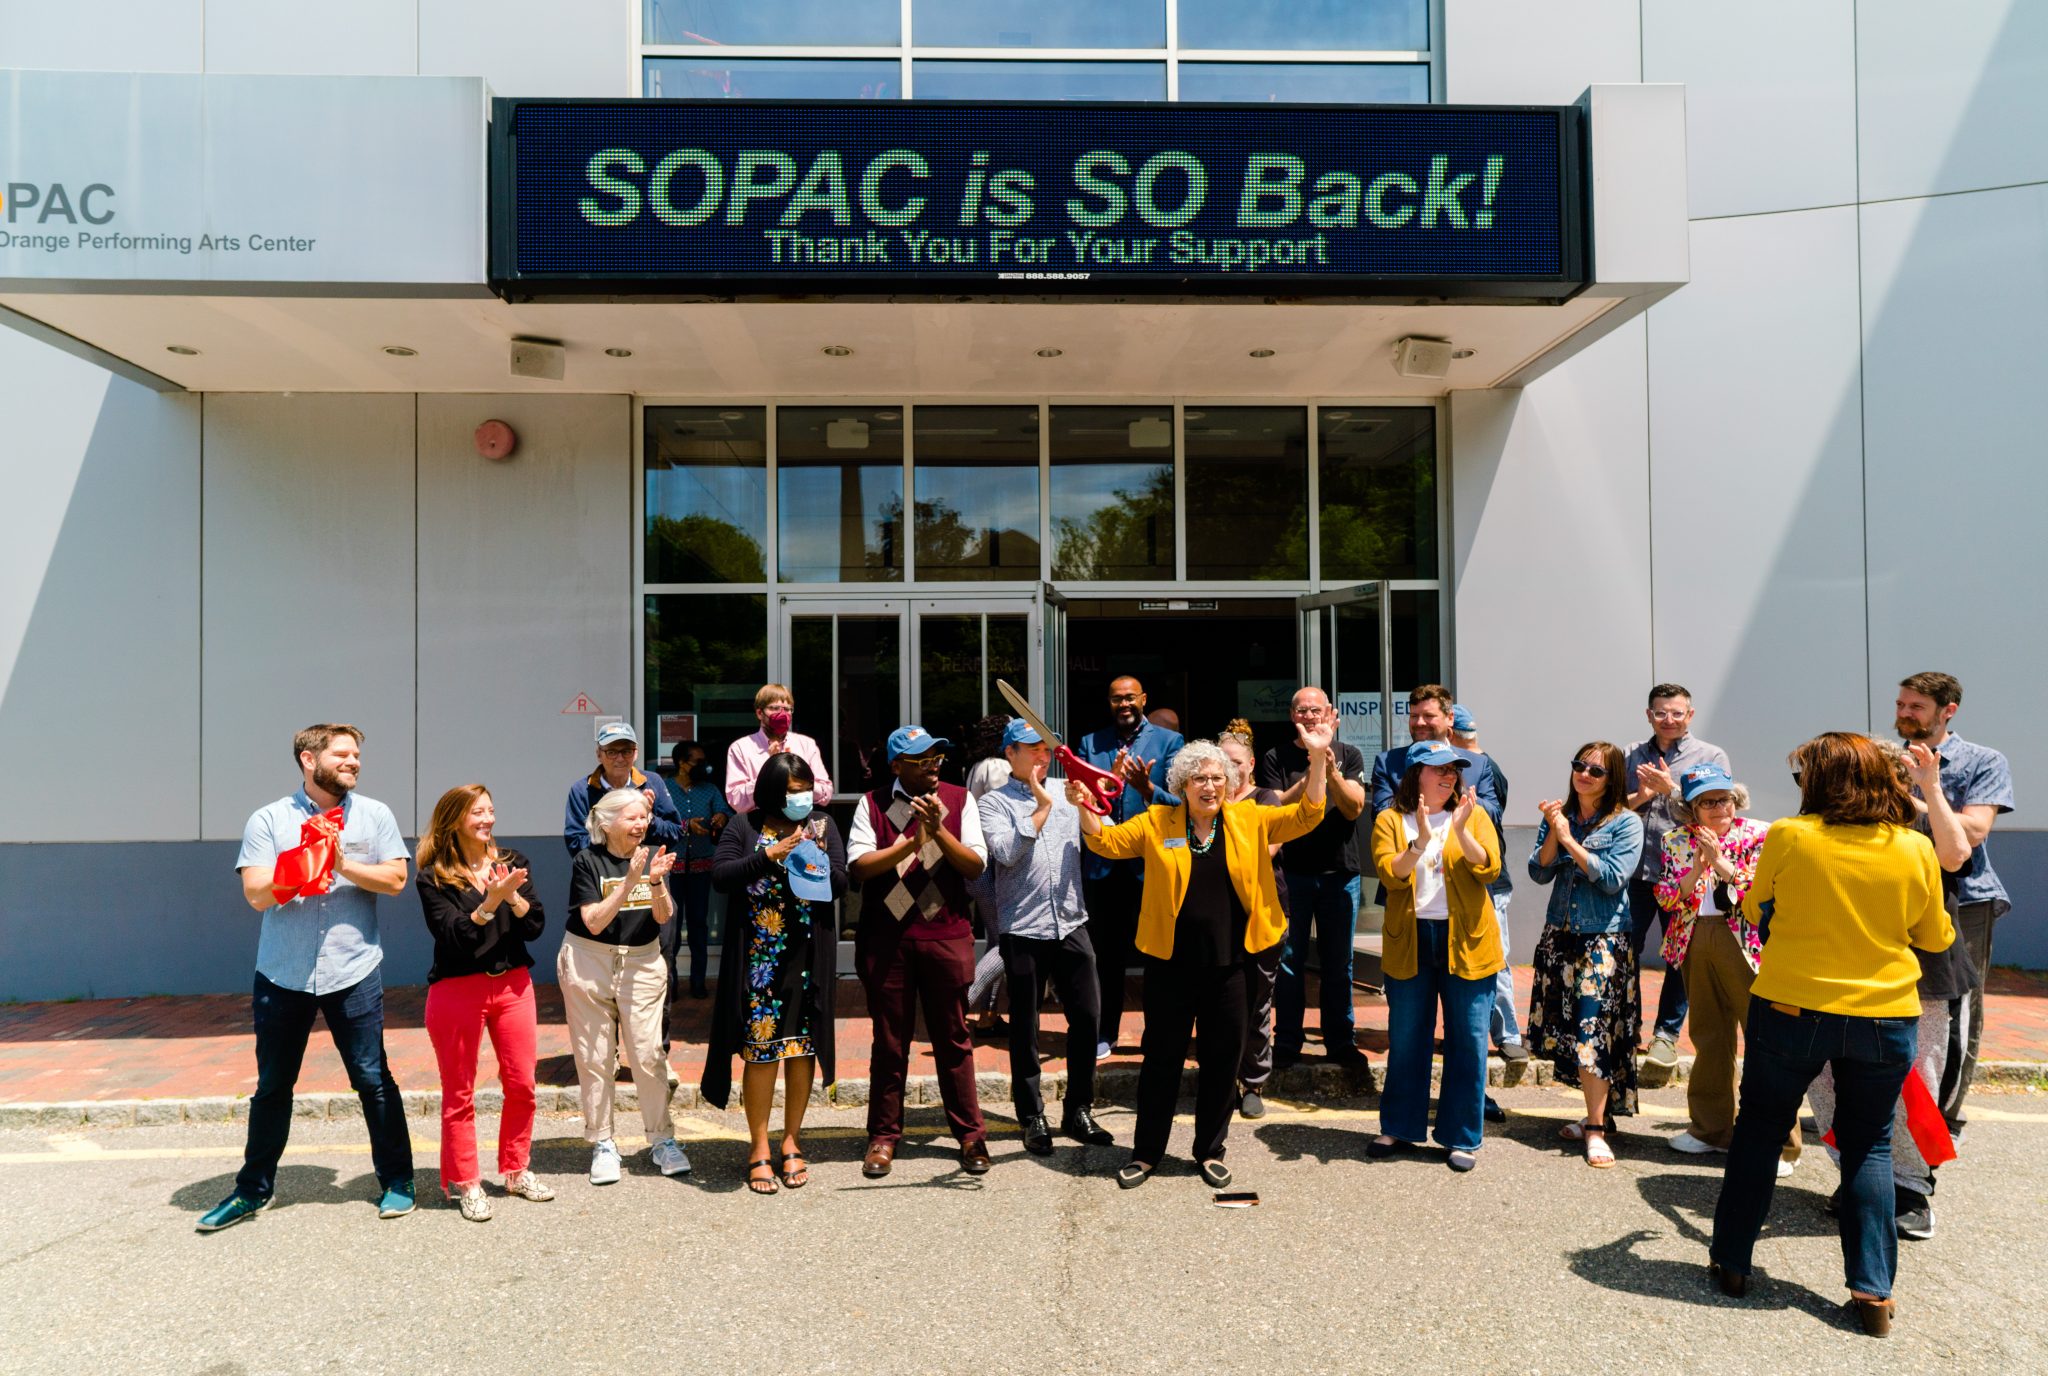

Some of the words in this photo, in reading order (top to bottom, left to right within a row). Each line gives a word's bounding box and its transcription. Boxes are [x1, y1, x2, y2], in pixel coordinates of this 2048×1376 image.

[0, 182, 115, 225] PAC
[578, 148, 931, 226] SOPAC
[958, 150, 1036, 227] is
[1065, 149, 1209, 228] SO
[1236, 152, 1505, 230] Back!
[78, 232, 192, 254] Performing
[198, 233, 241, 251] Arts
[248, 234, 316, 252] Center
[764, 230, 892, 264] Thank
[900, 230, 978, 264] You
[989, 230, 1056, 264] For
[1067, 230, 1160, 264] Your
[1169, 231, 1330, 272] Support
[577, 698, 588, 712] R
